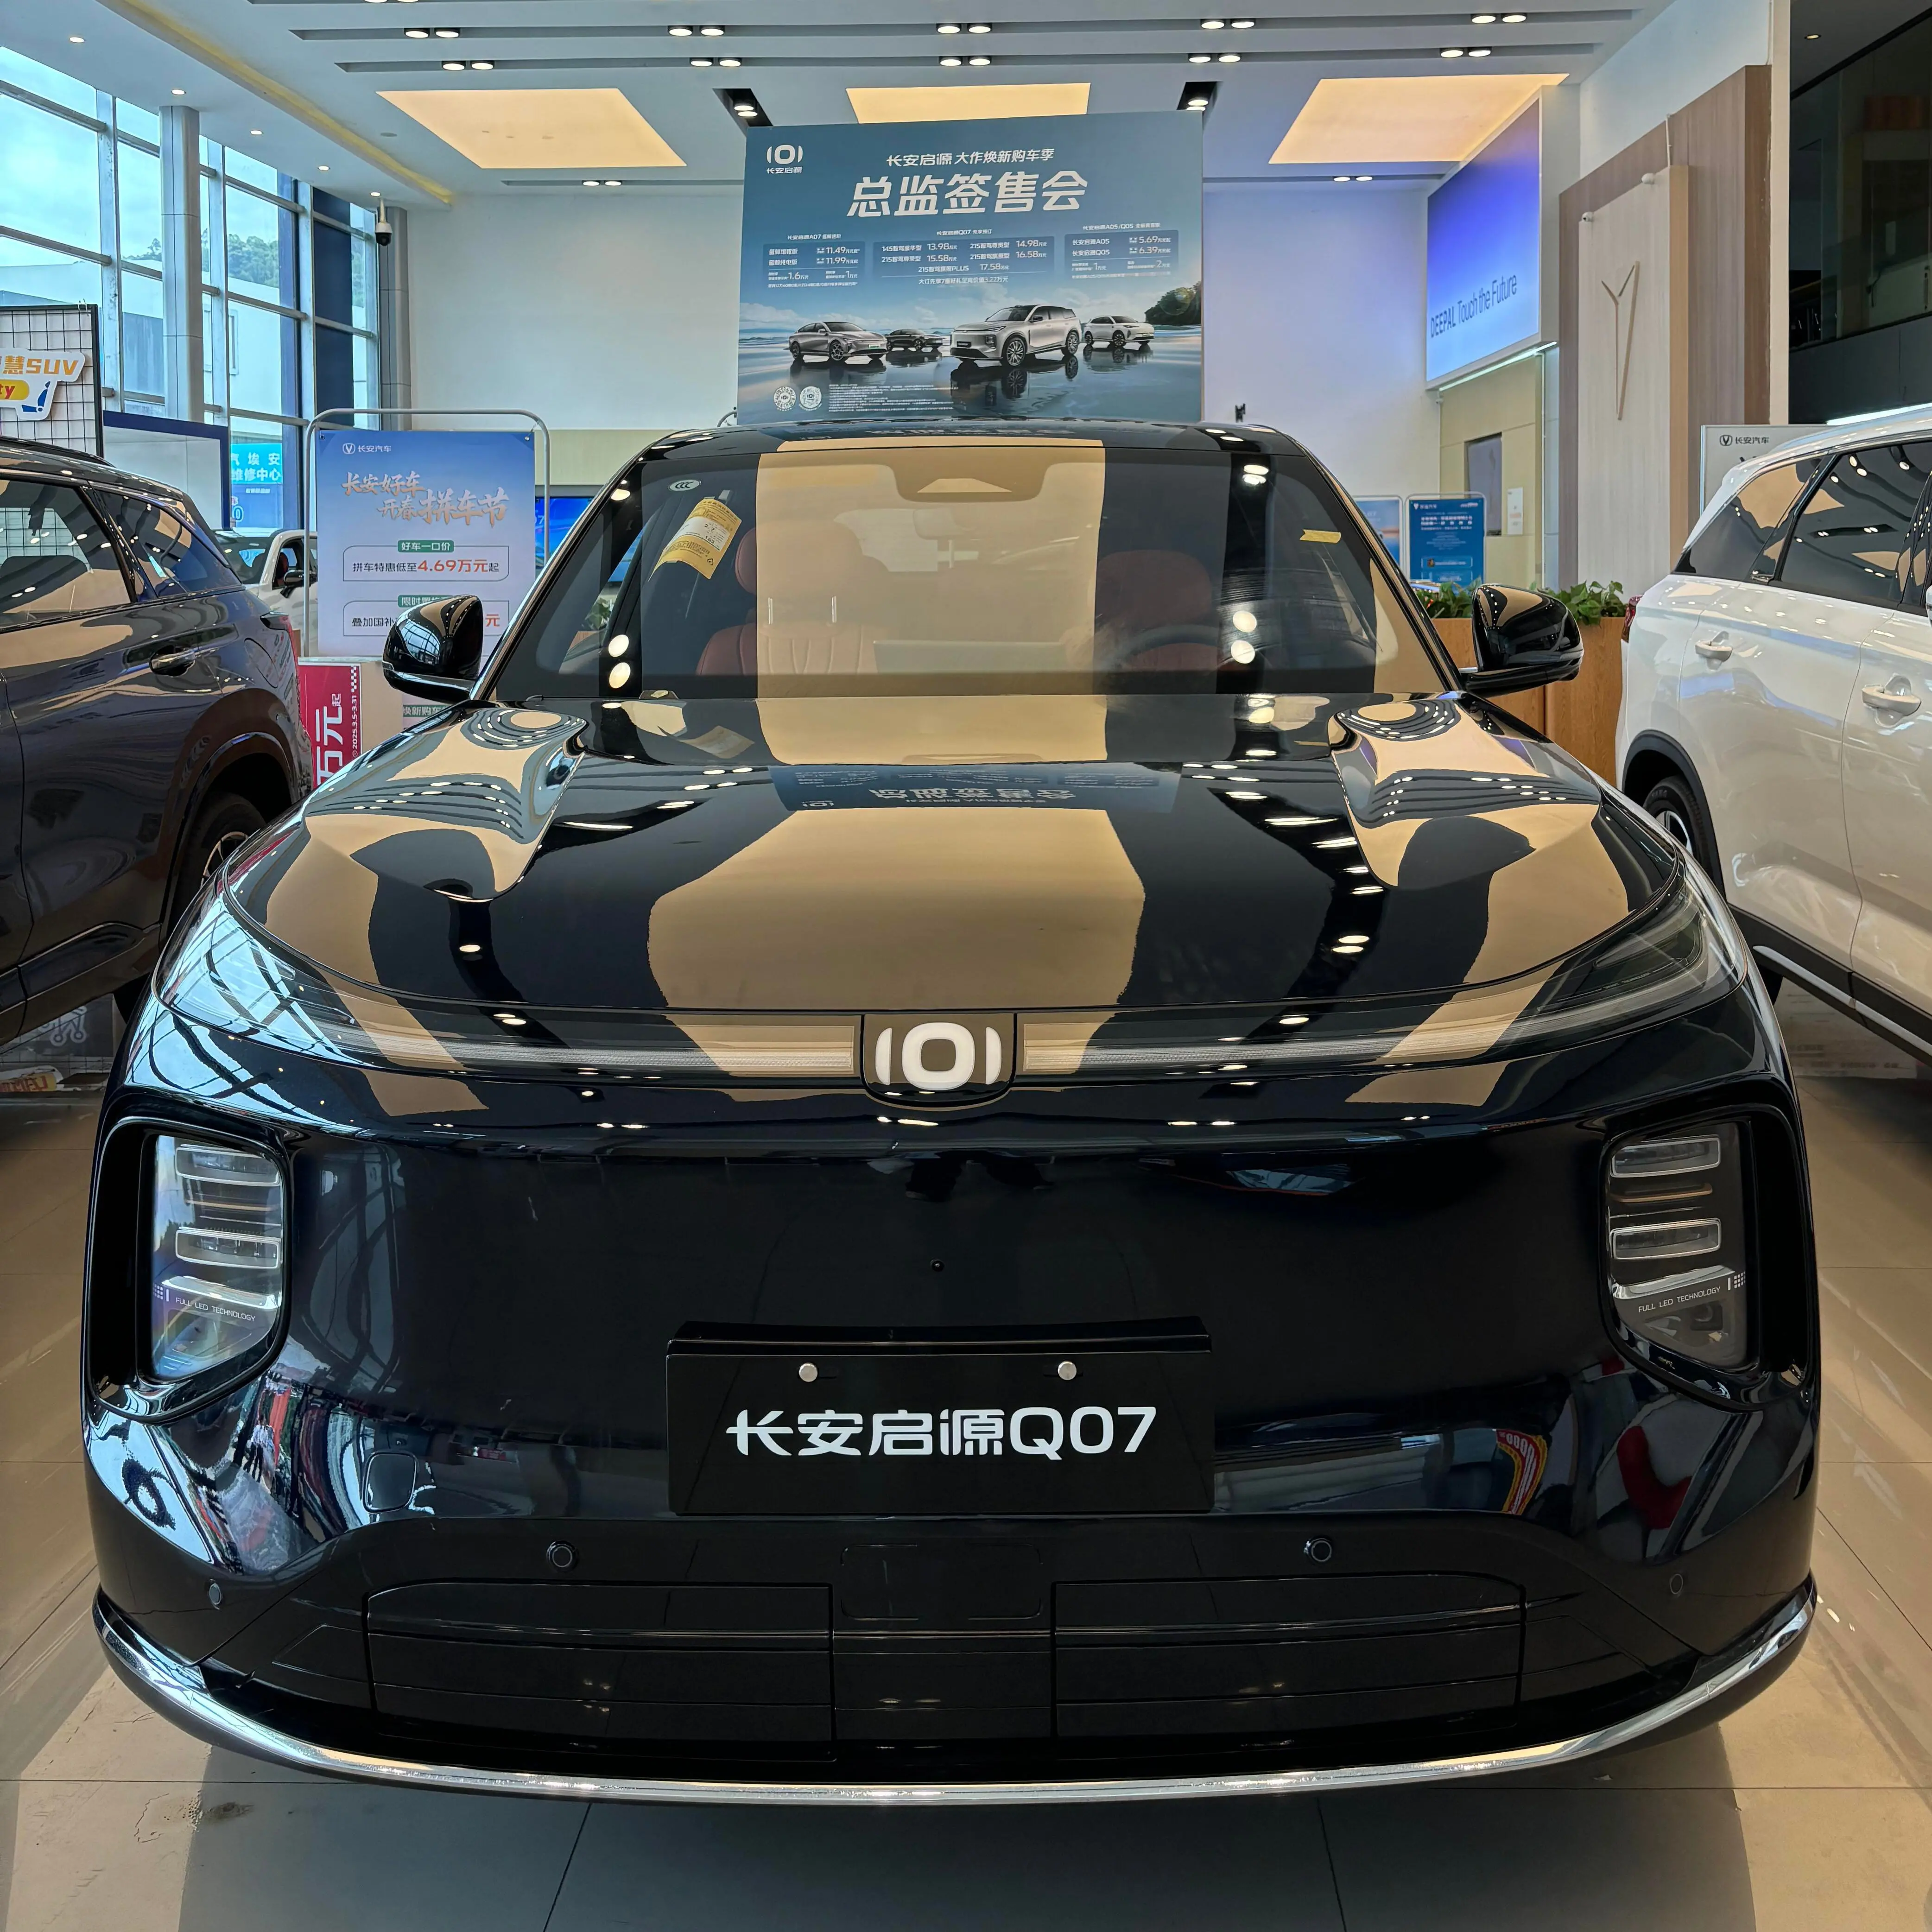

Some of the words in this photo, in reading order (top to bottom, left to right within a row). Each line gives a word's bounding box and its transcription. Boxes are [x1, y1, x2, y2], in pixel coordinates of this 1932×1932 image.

[887, 152, 952, 167] 长安启源
[954, 148, 1055, 164] 大作焕新购车季
[847, 171, 1088, 217] 总监签售会
[1431, 306, 1456, 338] DEEPAL
[1457, 292, 1477, 324] Touch
[1479, 287, 1490, 313] the
[1492, 275, 1517, 306] Future
[0, 355, 79, 375] 慧SUV
[342, 470, 426, 498] 长安好车
[377, 487, 509, 527] 开春拼车节
[401, 542, 451, 551] 好车一口价
[352, 559, 499, 572] 拼车特惠低至4.69万元起
[352, 617, 397, 627] 叠加国补
[176, 1297, 192, 1307] FULL
[195, 1303, 208, 1311] LED
[212, 1306, 255, 1322] TECHNOLOGY
[1638, 1303, 1656, 1312] FULL
[1659, 1299, 1673, 1308] LED
[1677, 1286, 1720, 1303] TECHNOLOGY
[726, 1406, 1157, 1461] 长安启源Q07
